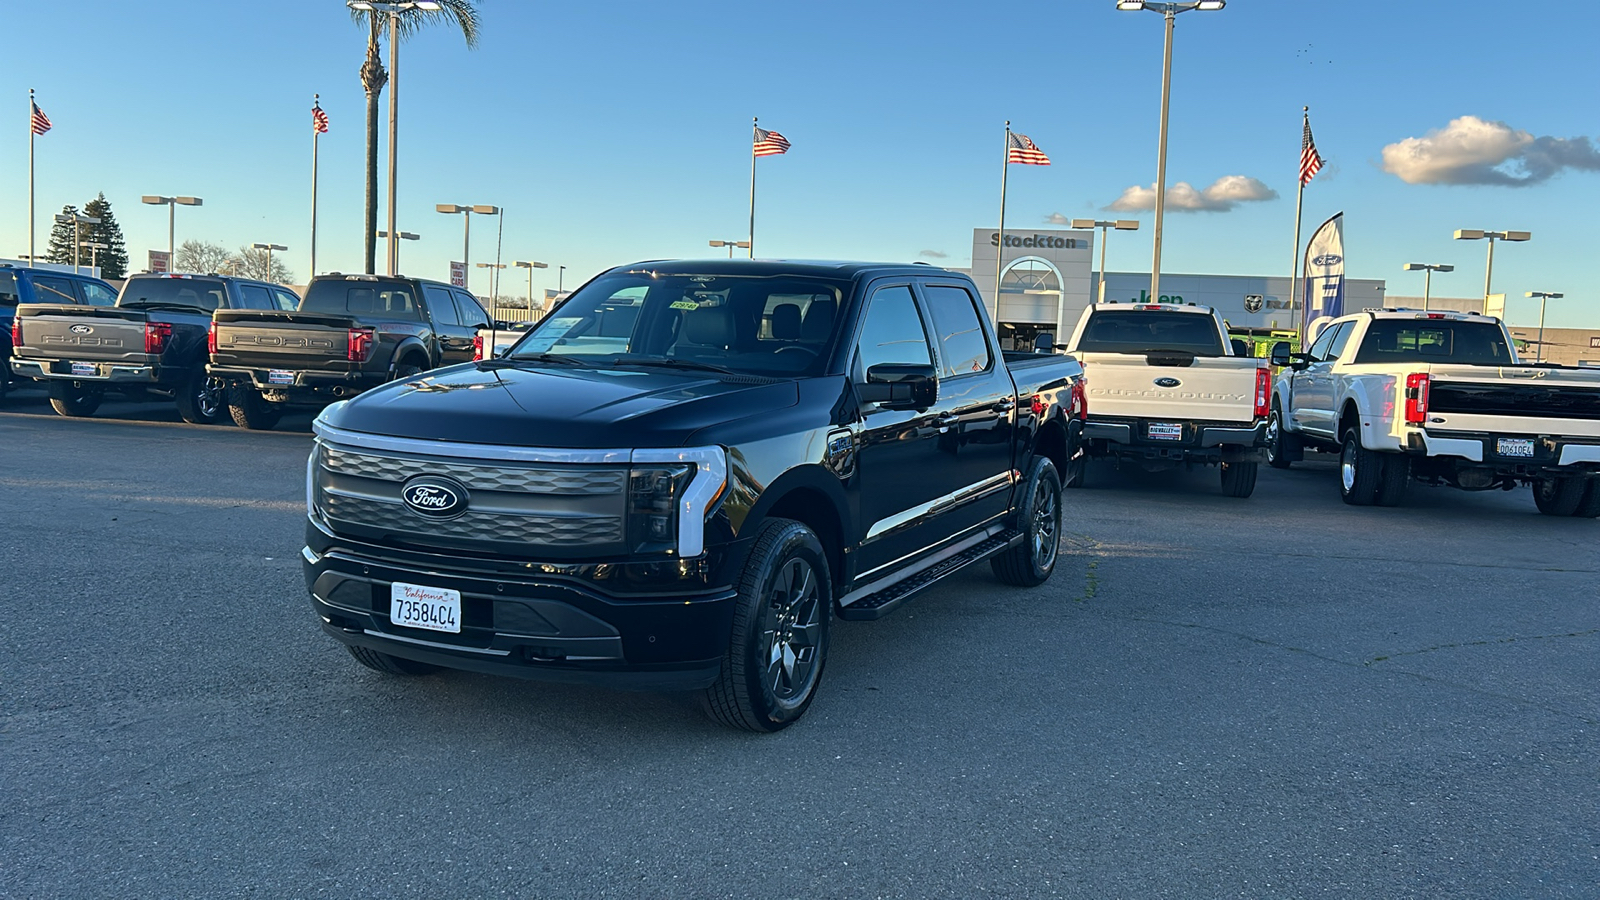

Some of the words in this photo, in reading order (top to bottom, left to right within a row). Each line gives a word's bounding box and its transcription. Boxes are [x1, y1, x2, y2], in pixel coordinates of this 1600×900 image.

[990, 232, 1077, 249] Stockton
[1316, 255, 1338, 265] Ford
[451, 277, 464, 287] CARS
[230, 335, 334, 348] FORD
[1180, 391, 1246, 401] DUTY
[412, 487, 448, 507] Ford
[405, 586, 447, 602] California
[395, 598, 456, 627] 73584C4
